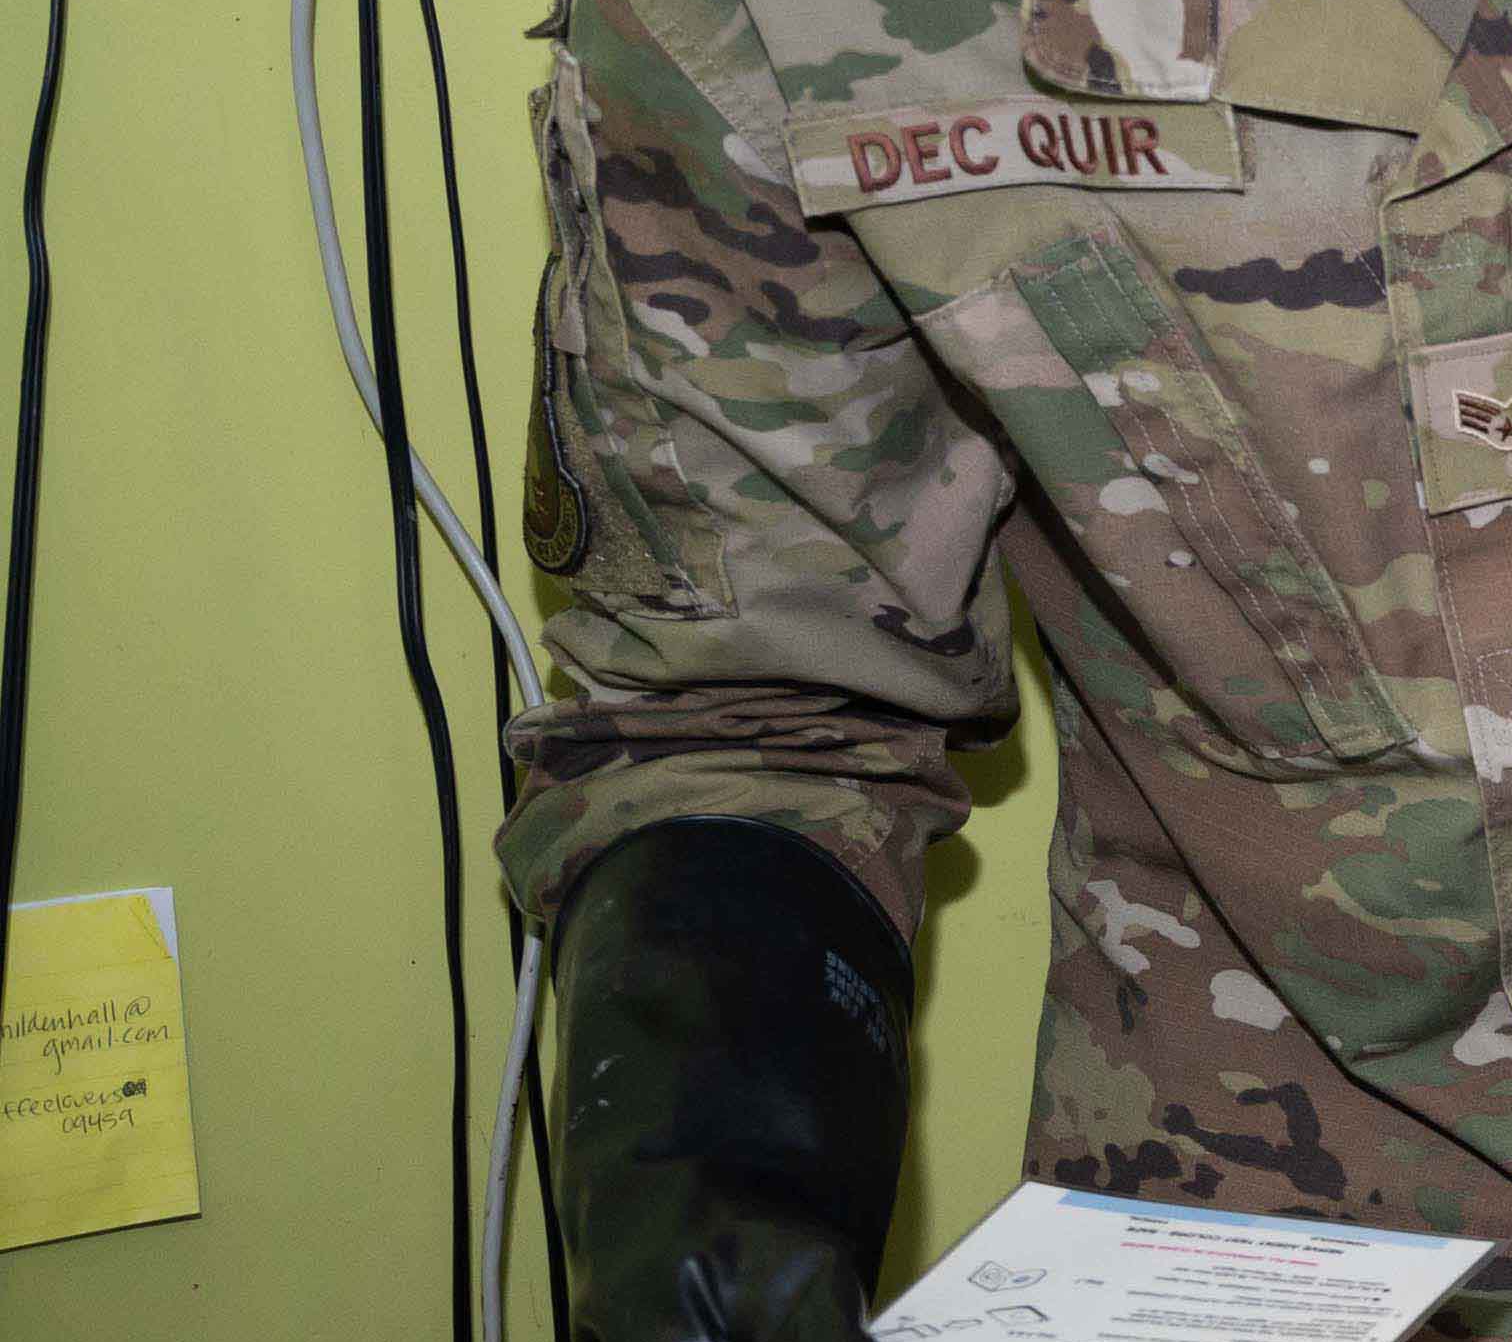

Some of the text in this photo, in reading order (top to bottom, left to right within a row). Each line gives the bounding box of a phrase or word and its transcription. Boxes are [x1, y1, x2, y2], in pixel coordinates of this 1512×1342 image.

[846, 110, 1170, 195] DEC QUIR
[43, 1024, 169, 1075] gmail.com
[62, 1107, 135, 1134] 09459
